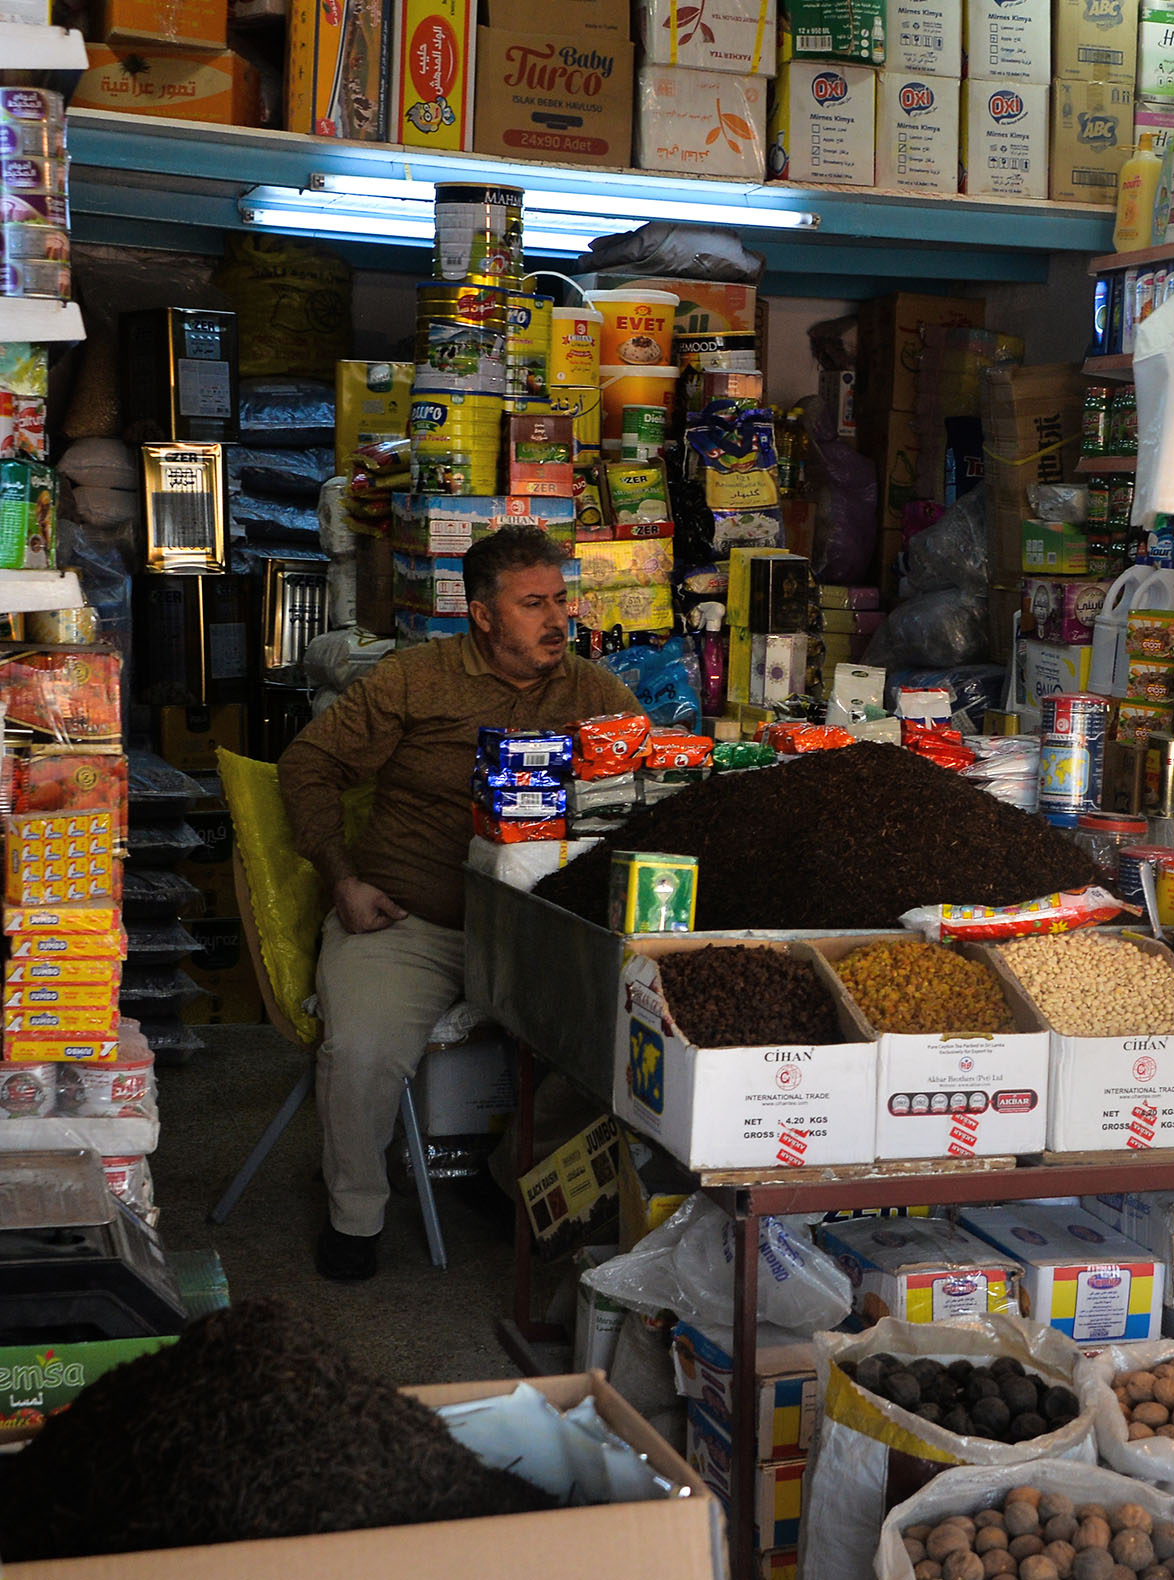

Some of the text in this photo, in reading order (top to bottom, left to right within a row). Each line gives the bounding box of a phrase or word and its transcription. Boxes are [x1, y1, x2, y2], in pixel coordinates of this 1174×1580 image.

[417, 42, 430, 75] حليب
[710, 50, 751, 62] FAKHER TEA
[559, 47, 614, 77] Baby
[504, 44, 602, 97] Turco
[101, 75, 196, 100] تمور عراقية
[512, 95, 536, 106] ISLAK
[537, 98, 563, 109] BEBEK
[1083, 120, 1115, 139] ABC
[521, 132, 593, 151] 24x90 Adet
[616, 316, 665, 332] EVET
[171, 452, 198, 464] ZER
[625, 474, 648, 485] ZER
[533, 482, 557, 493] ZER
[637, 525, 660, 536] ZER
[30, 914, 58, 925] JUMBO
[38, 940, 67, 951] JUMBO
[31, 966, 60, 977] JUMBO
[30, 991, 58, 1002] JUMBO
[30, 1015, 59, 1026] JUMBO
[948, 1075, 975, 1083] Brothers
[745, 1092, 830, 1102] INTERNATIONAL TRADE
[1103, 1087, 1152, 1096] INTERNATIONAL
[999, 1098, 1030, 1107] AKBAR
[1102, 1109, 1120, 1119] NET
[744, 1115, 828, 1126] NET 4.20 KGS
[1101, 1122, 1130, 1131] GROSS
[584, 1114, 618, 1156] JUMBO
[743, 1129, 828, 1140] GROSS KGS
[526, 1168, 560, 1202] BLACK RAISIN
